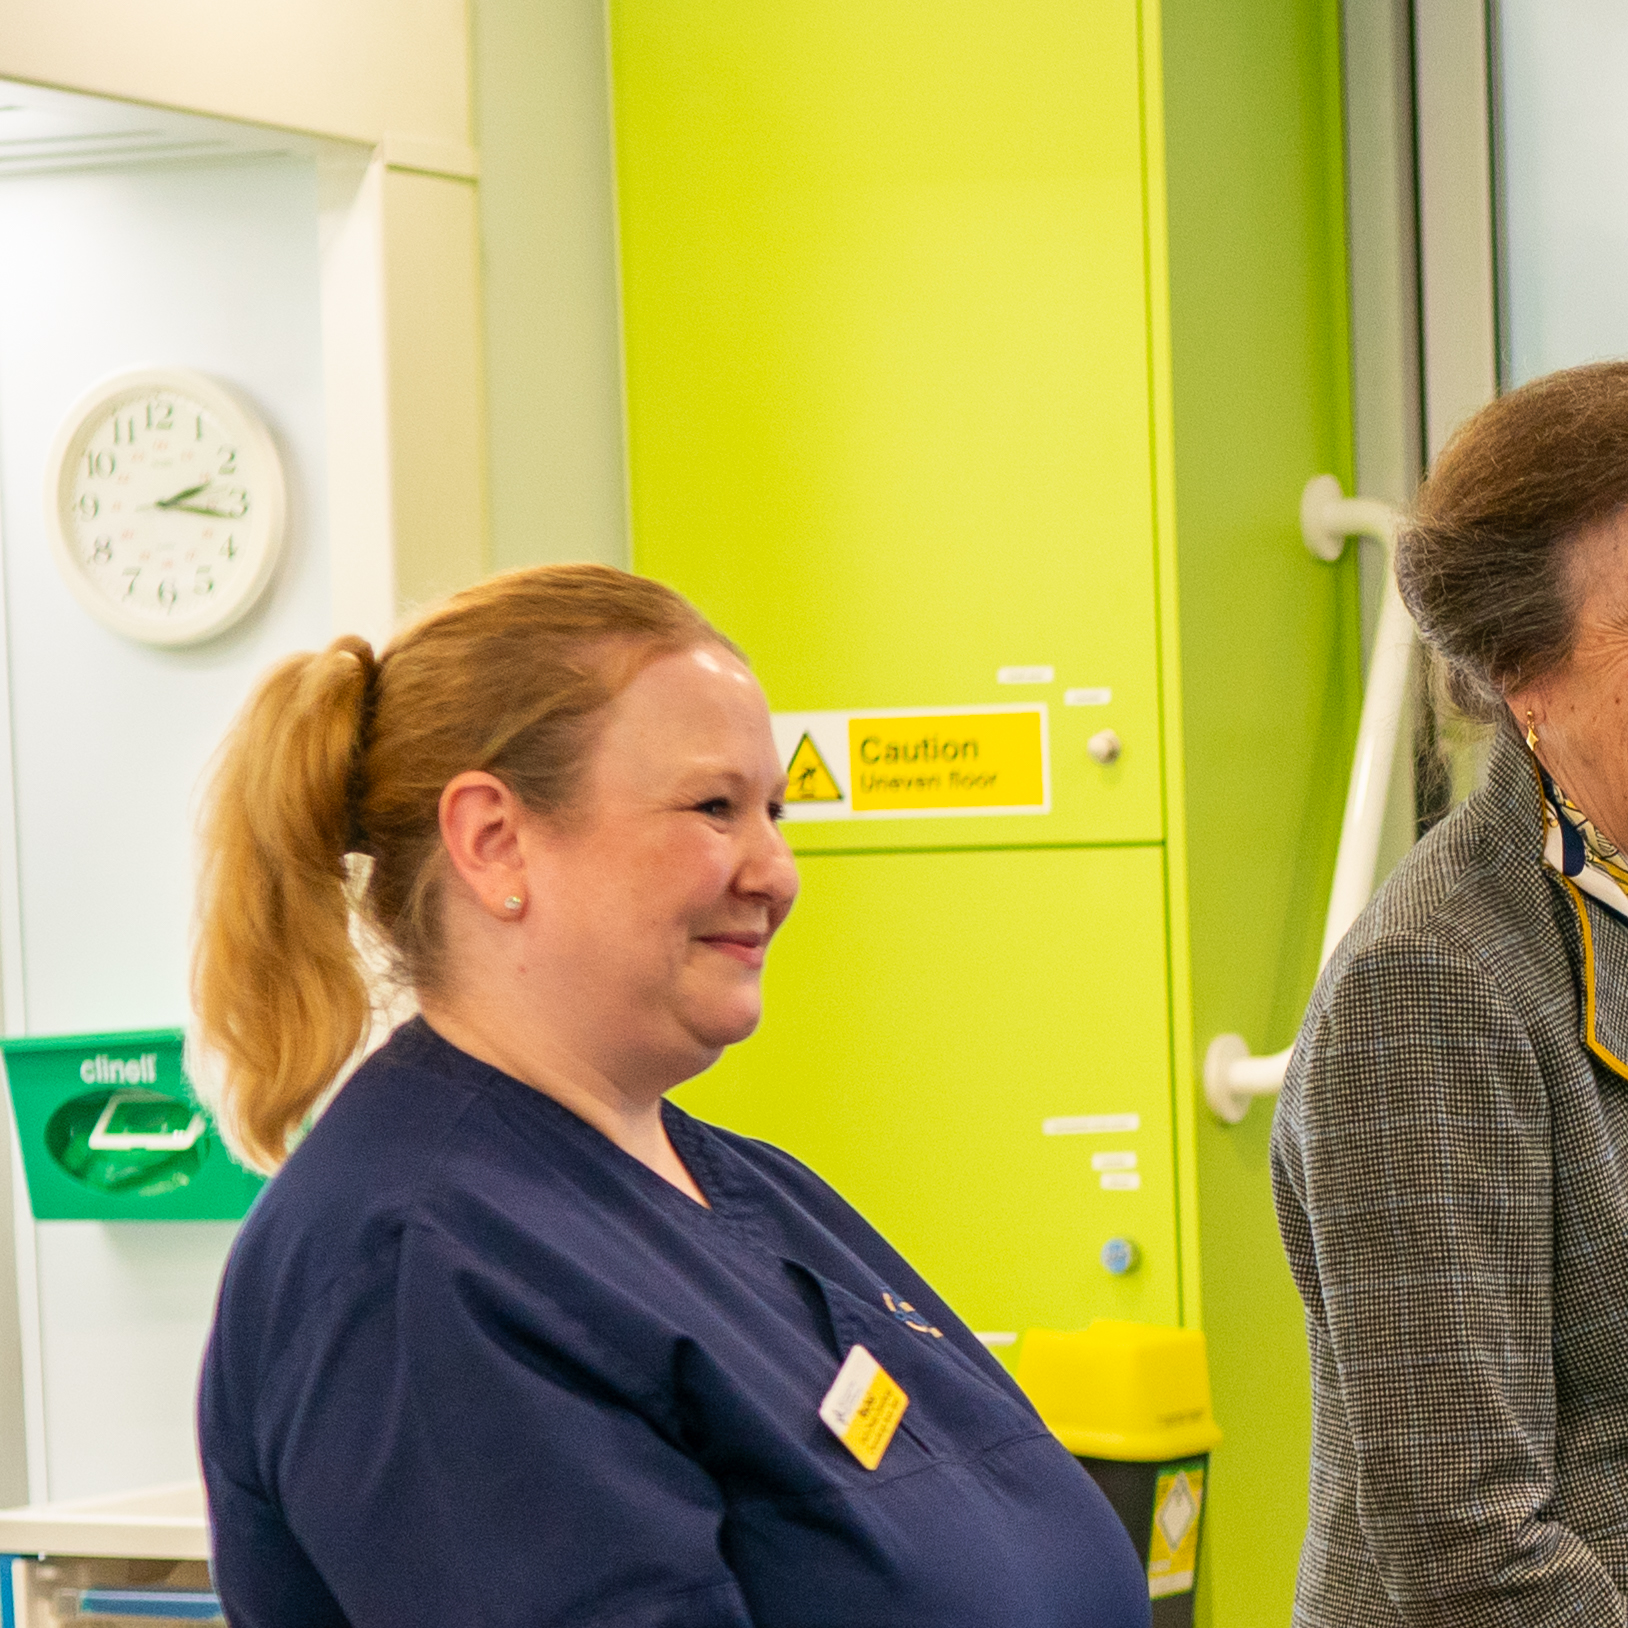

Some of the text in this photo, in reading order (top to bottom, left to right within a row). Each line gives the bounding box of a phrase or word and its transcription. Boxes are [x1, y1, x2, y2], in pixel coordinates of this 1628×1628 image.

[113, 416, 136, 445] 11
[145, 402, 174, 431] 12
[195, 414, 203, 442] 1
[86, 450, 117, 479] 10
[217, 445, 237, 475] 2
[79, 491, 100, 522] 9
[228, 488, 249, 517] 3
[93, 535, 112, 565] 8
[218, 534, 238, 561] 4
[122, 567, 143, 601] 7
[193, 565, 214, 596] 5
[157, 580, 178, 614] 6
[860, 733, 980, 765] Caution
[860, 770, 998, 794] Uneven floor
[80, 1053, 157, 1084] clinell
